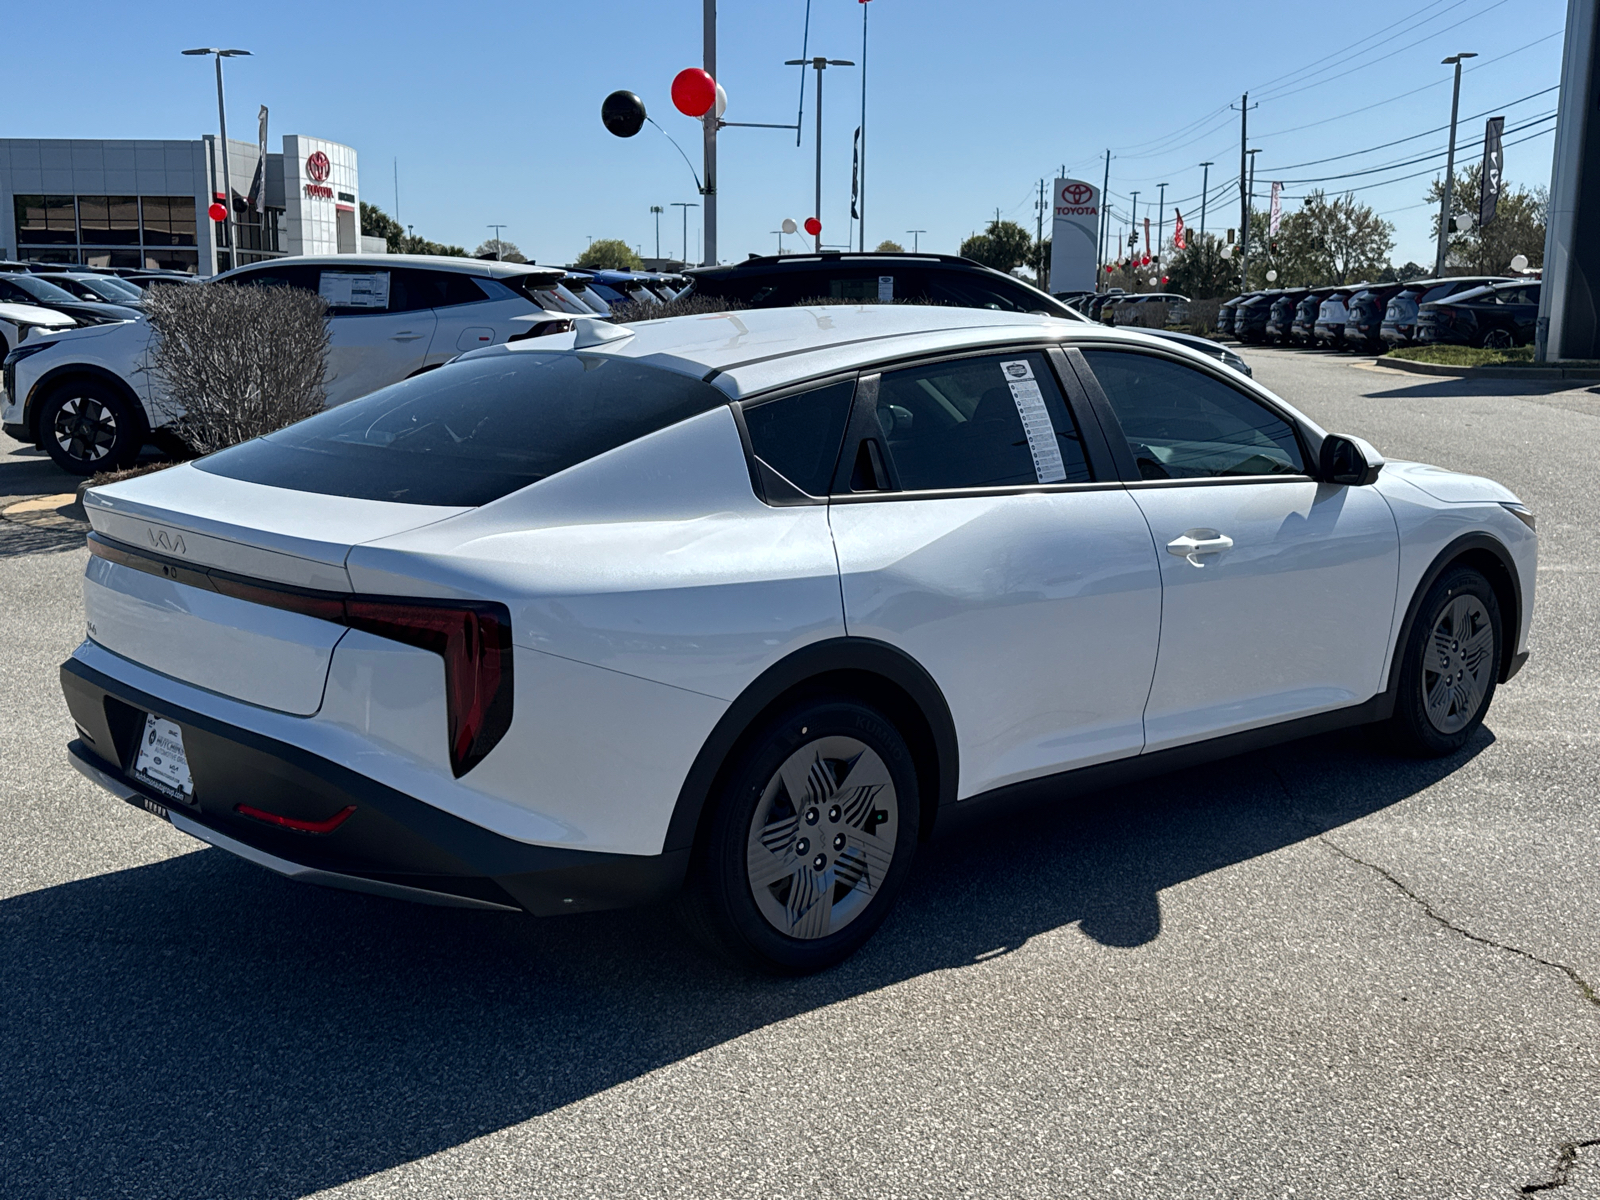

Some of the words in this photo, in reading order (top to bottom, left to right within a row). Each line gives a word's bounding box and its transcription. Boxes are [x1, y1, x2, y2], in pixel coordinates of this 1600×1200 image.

[305, 184, 334, 199] TOYOTA
[1055, 206, 1098, 216] TOYOTA
[147, 528, 187, 554] KIA
[855, 716, 902, 760] KUMHO
